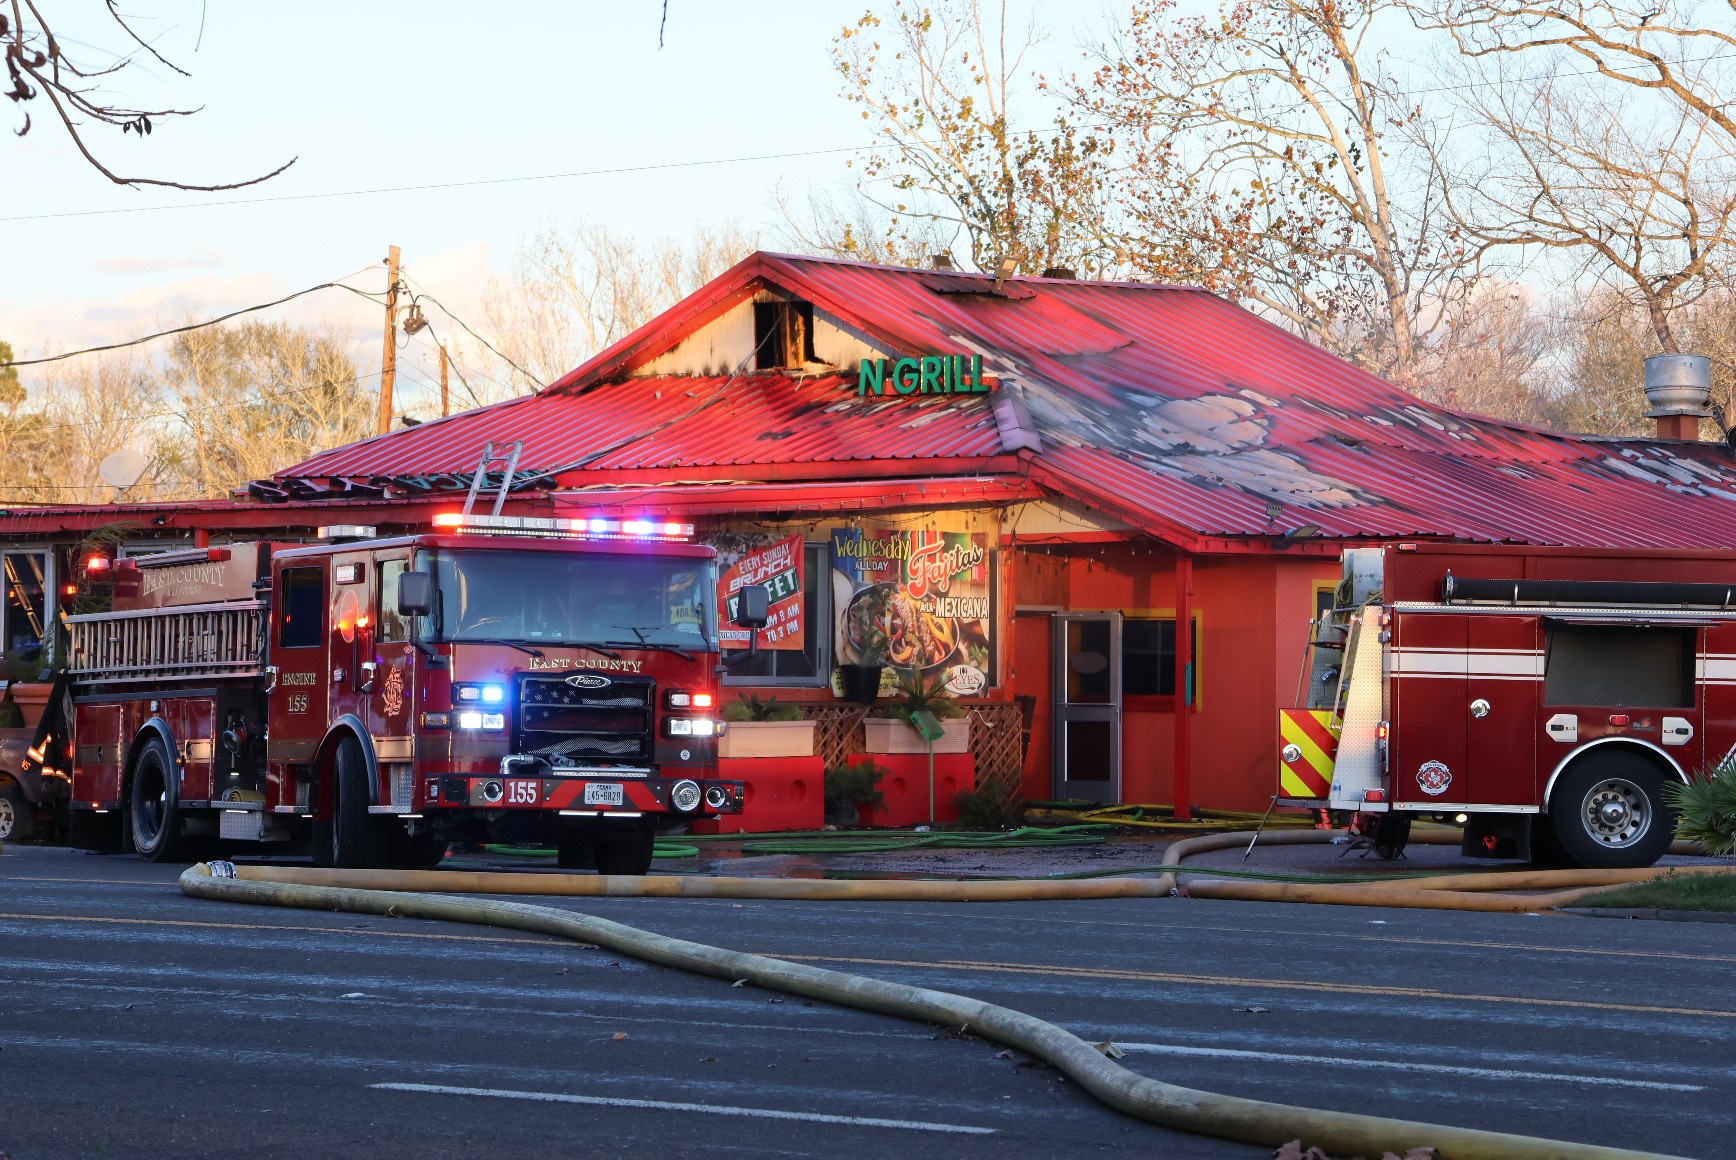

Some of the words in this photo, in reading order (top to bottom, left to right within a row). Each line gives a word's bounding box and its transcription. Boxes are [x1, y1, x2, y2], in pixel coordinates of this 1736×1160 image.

[857, 358, 884, 396] N
[892, 353, 990, 394] GRILL
[738, 554, 761, 575] EVERY
[762, 542, 791, 565] SUNDAY
[834, 534, 911, 561] Wednesday
[729, 554, 792, 592] BRUNCH
[855, 559, 870, 571] ALL
[872, 561, 889, 572] DAY
[907, 539, 984, 599] Fajitas
[143, 571, 173, 597] EAST
[176, 564, 225, 589] COUNTY
[729, 569, 796, 619] BFET
[779, 610, 786, 622] 8
[787, 603, 800, 619] AM
[935, 597, 989, 618] MEXICANA
[766, 629, 777, 643] TO
[778, 626, 784, 638] 3
[786, 620, 799, 636] PM
[529, 657, 570, 670] EAST
[575, 658, 643, 673] COUNTY
[281, 672, 317, 686] ENGINE
[574, 675, 602, 686] Pierce
[288, 694, 308, 712] 155
[508, 781, 537, 804] 155
